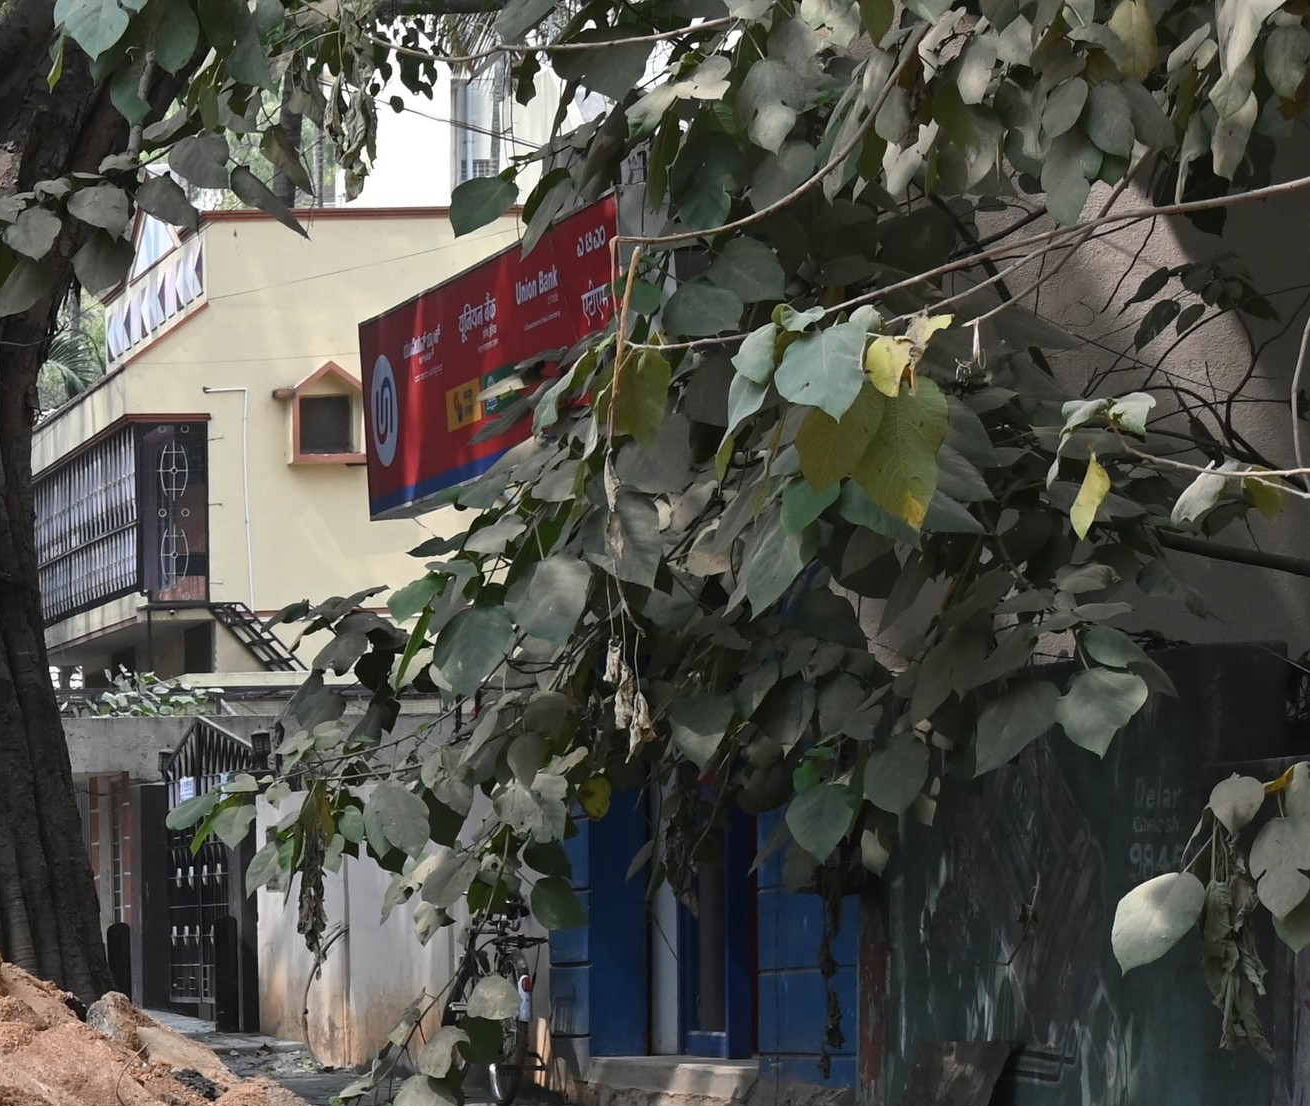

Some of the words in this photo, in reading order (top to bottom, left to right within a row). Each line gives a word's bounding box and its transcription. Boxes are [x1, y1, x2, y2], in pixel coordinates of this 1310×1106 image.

[515, 277, 537, 306] Union
[538, 263, 558, 294] Bank
[458, 303, 483, 344] यूनियन
